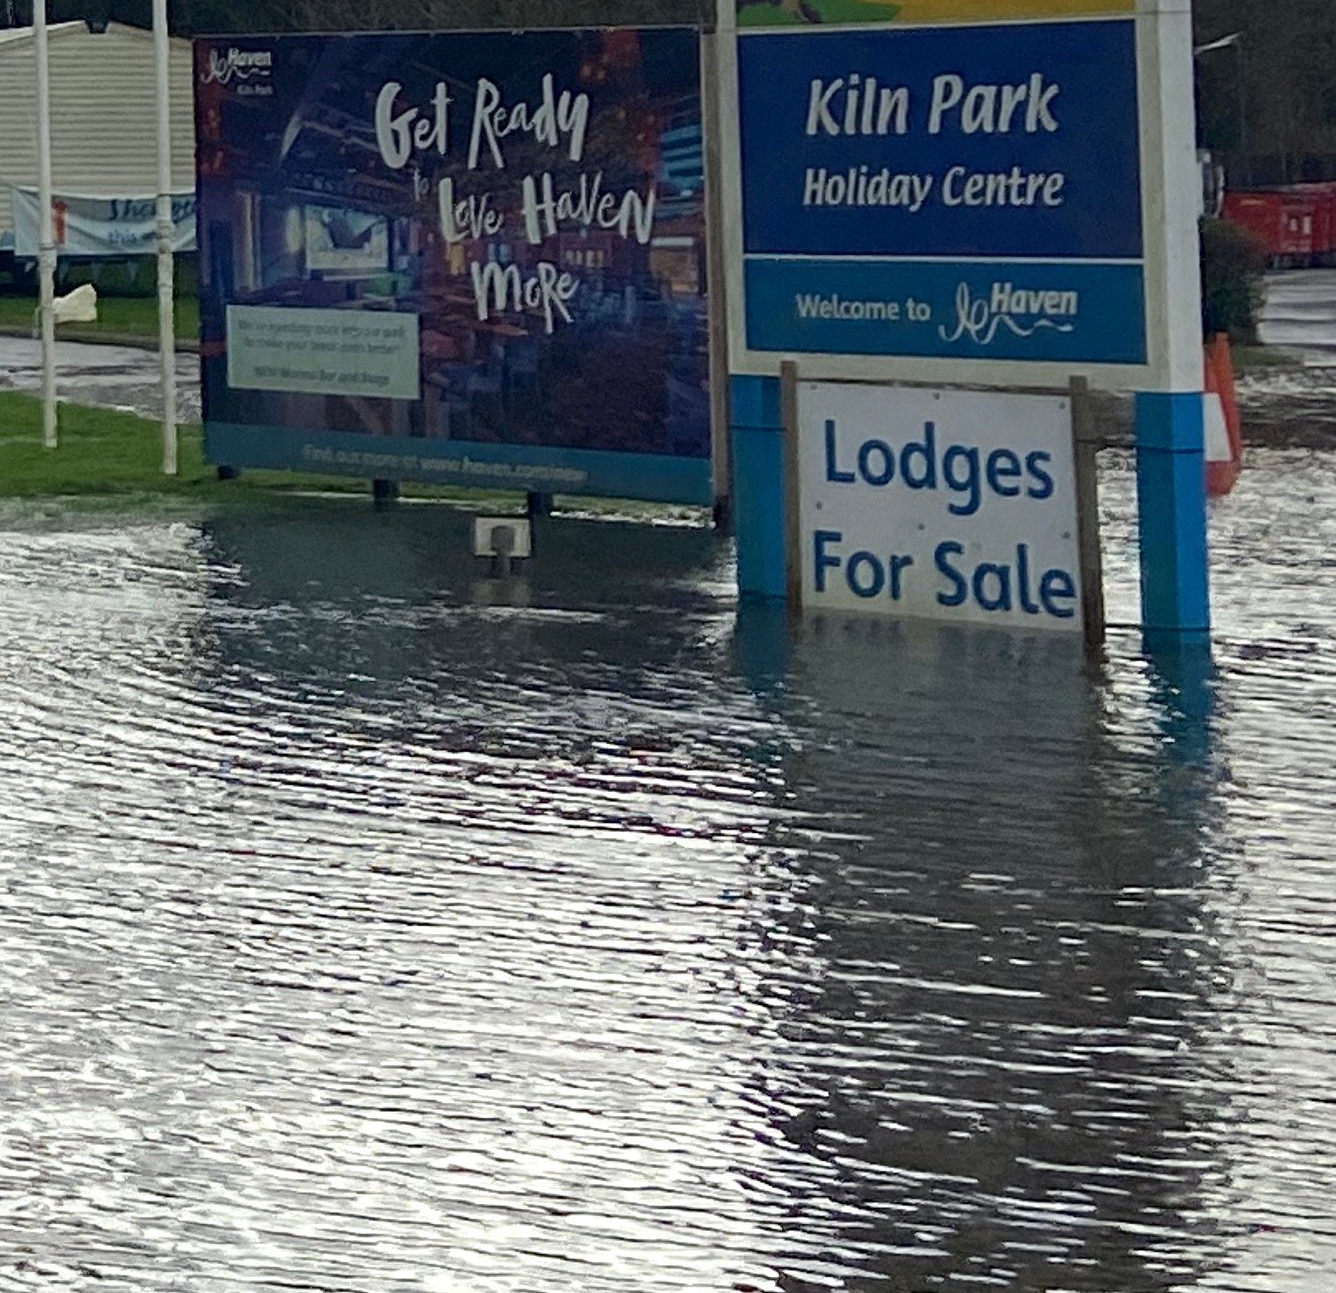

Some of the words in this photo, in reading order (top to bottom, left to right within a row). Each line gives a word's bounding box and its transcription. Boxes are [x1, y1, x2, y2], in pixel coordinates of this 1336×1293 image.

[375, 81, 454, 169] Get
[468, 73, 589, 169] Ready
[805, 73, 909, 135] Kiln
[929, 72, 1061, 134] Park
[802, 165, 933, 213] Holiday
[942, 165, 1065, 207] Centre
[795, 293, 900, 321] Welcome
[906, 296, 932, 322] to
[991, 282, 1078, 317] Haven
[824, 418, 1055, 517] Lodges
[813, 529, 914, 601] For
[934, 540, 1078, 618] Sale
